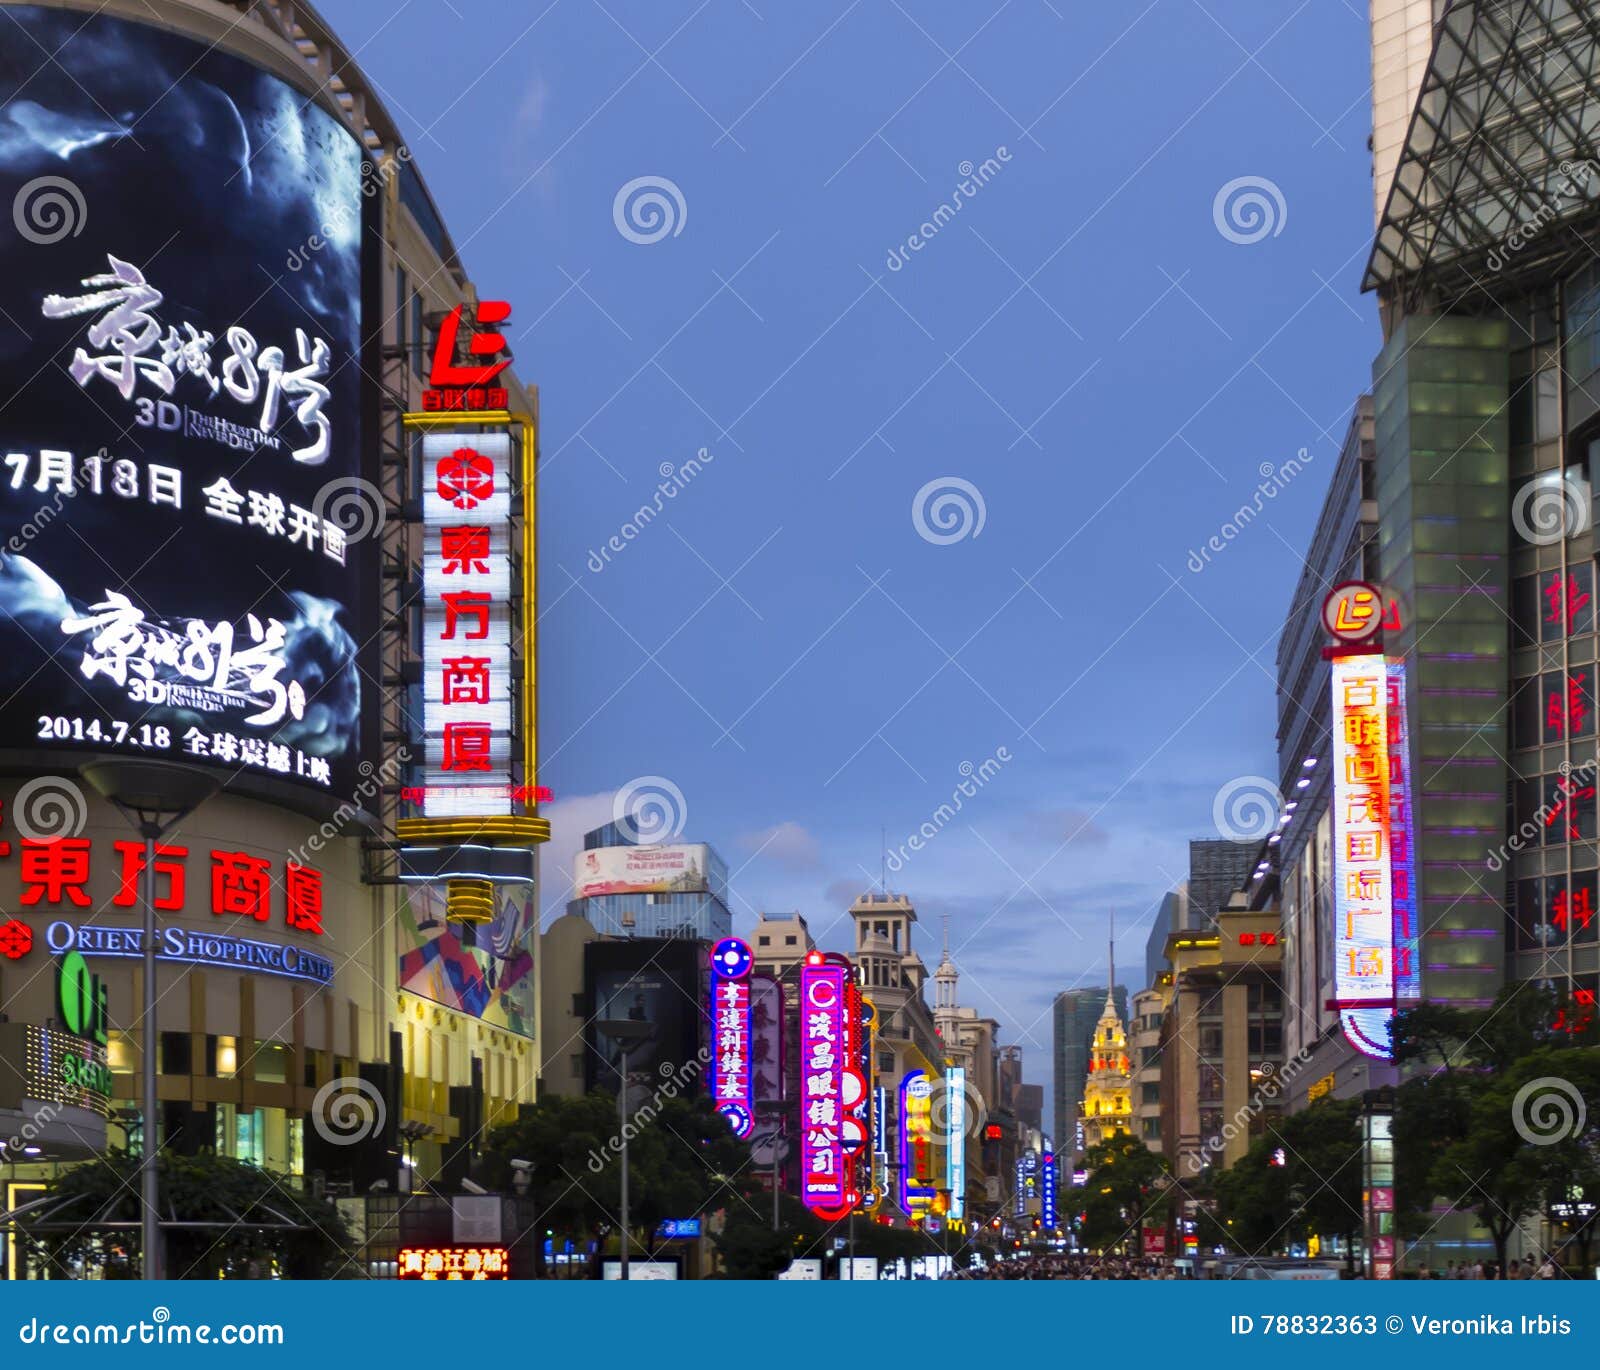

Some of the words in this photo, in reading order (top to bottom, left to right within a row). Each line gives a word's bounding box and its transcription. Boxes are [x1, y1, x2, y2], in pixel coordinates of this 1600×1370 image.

[134, 397, 182, 432] 3D
[4, 449, 183, 509] 7月18日
[202, 476, 348, 567] 全球开画
[127, 678, 168, 705] 3D
[36, 715, 172, 748] 2014.7.18
[46, 921, 161, 951] ORIEN
[164, 927, 281, 965] SHOPPING
